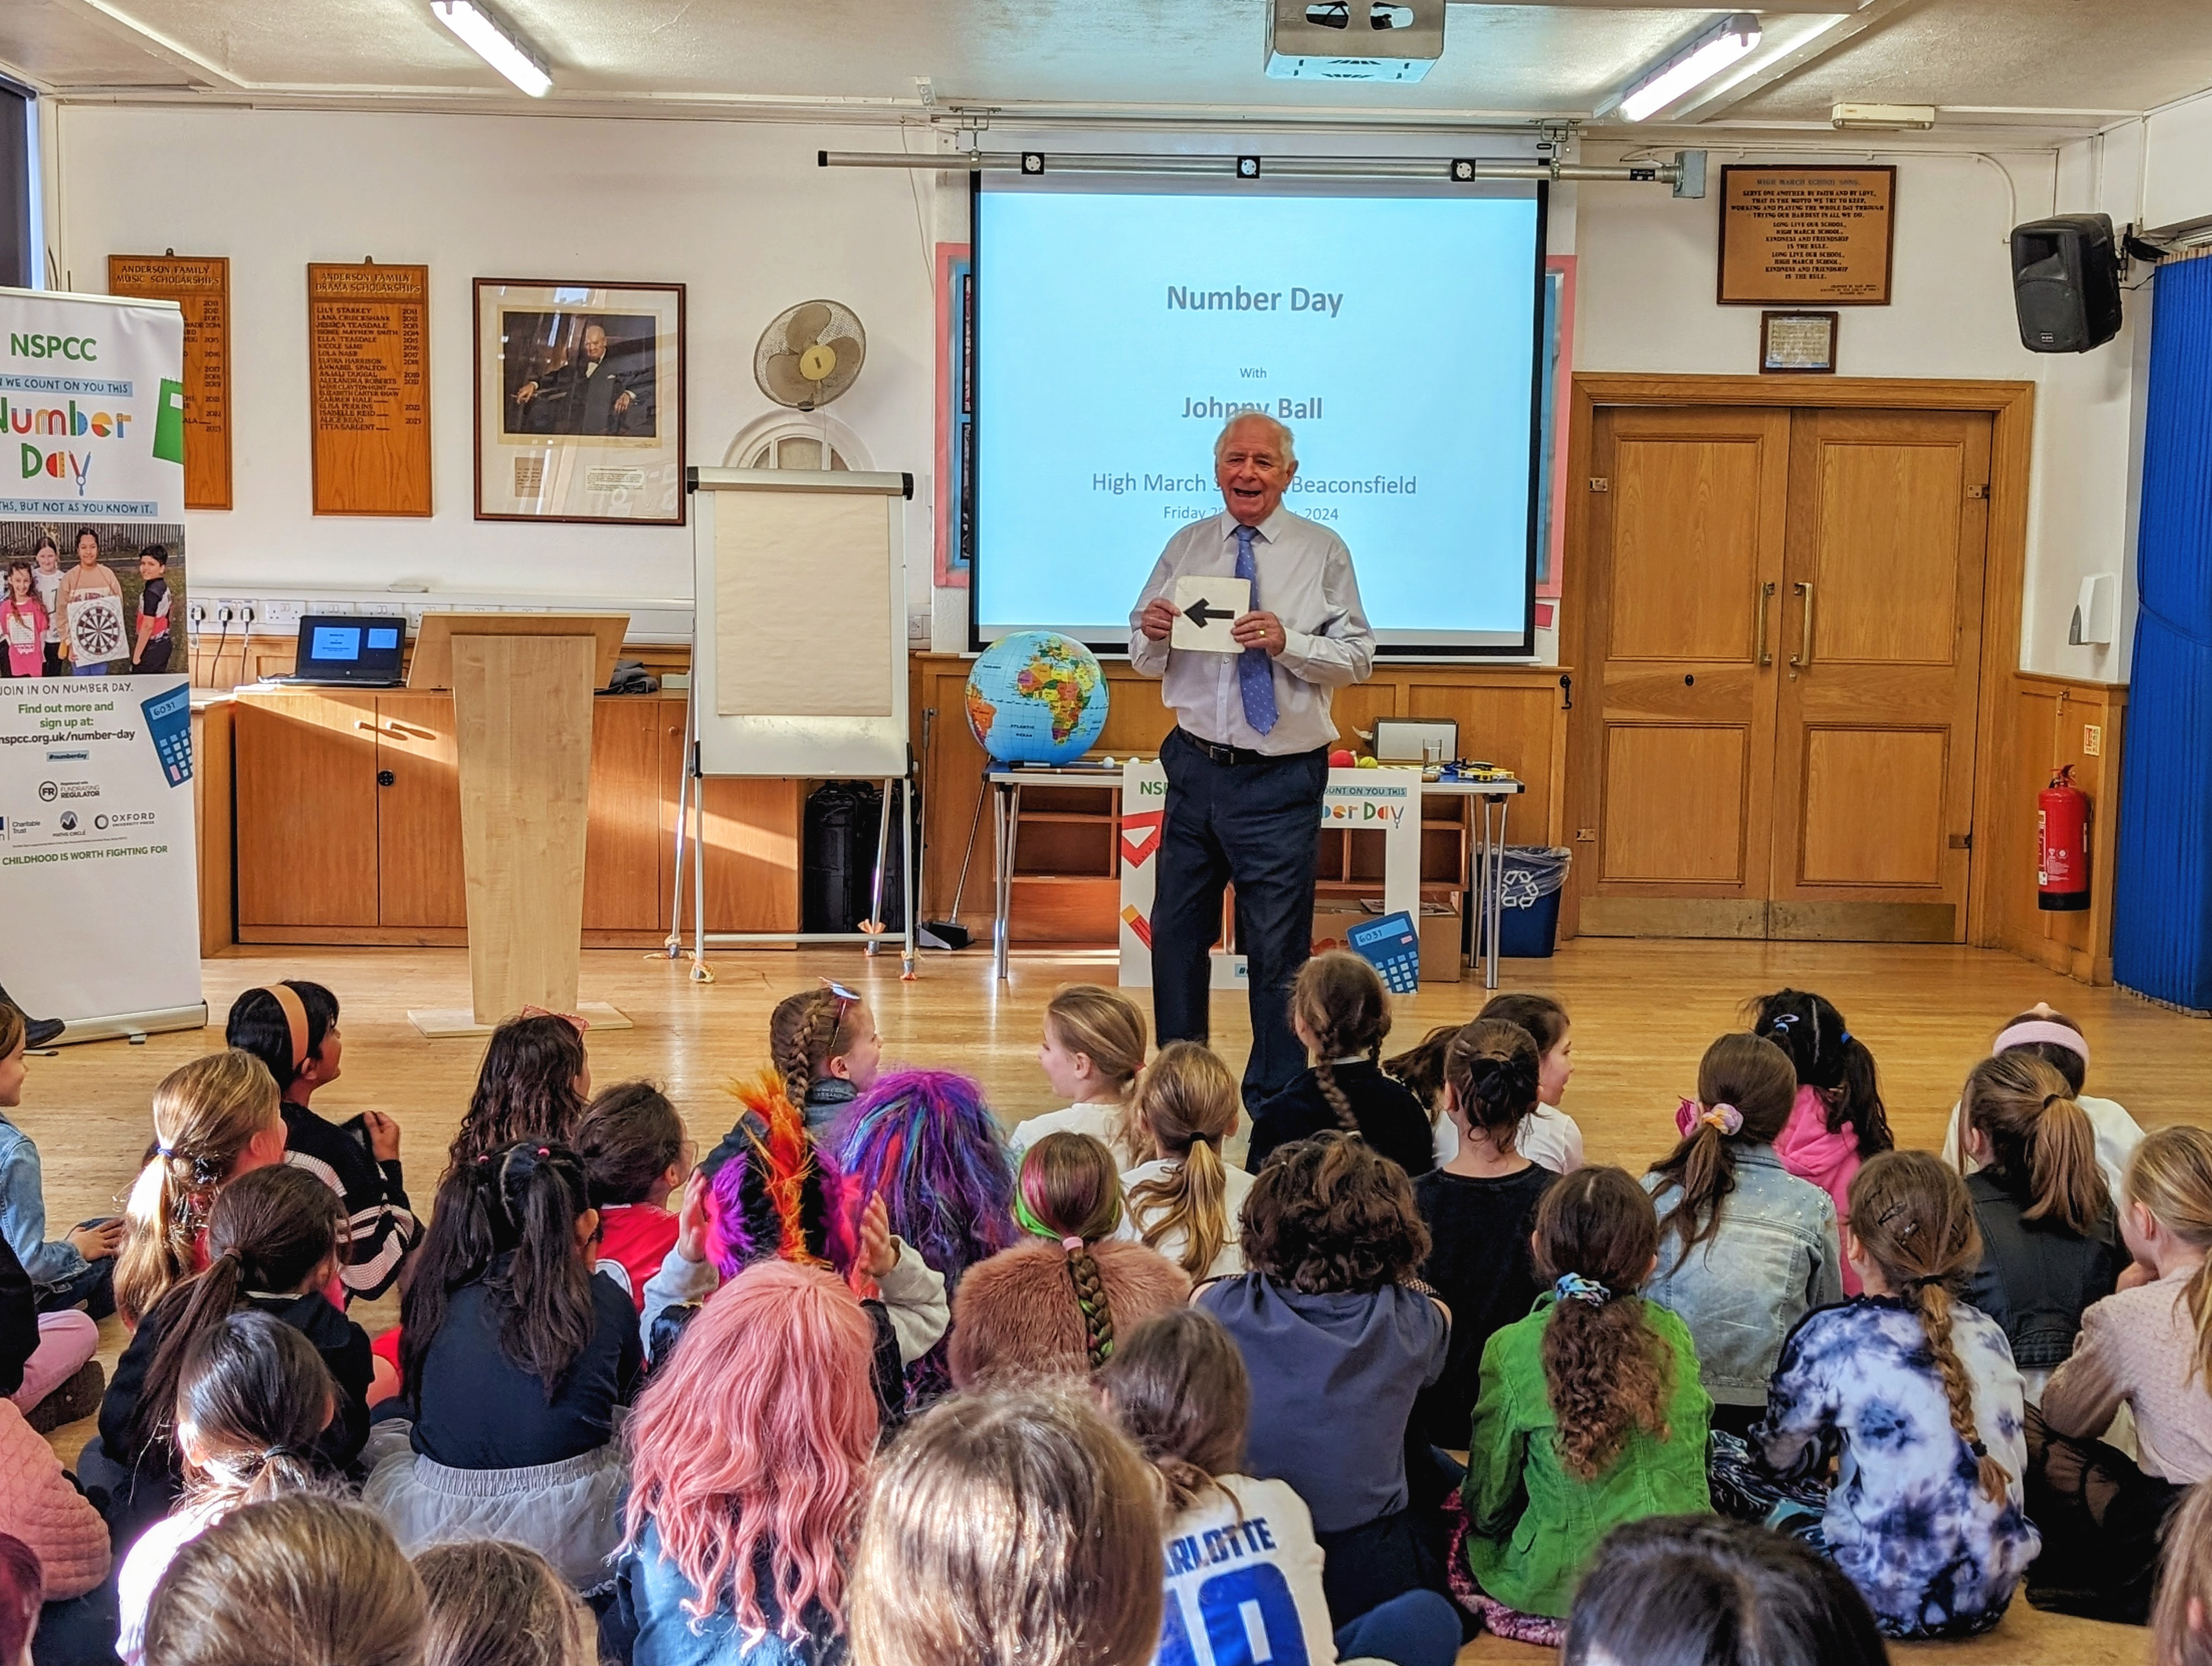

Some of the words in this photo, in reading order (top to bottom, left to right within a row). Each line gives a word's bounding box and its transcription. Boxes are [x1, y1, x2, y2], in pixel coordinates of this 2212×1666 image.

[151, 276, 219, 285] SCHOLARSHIPS
[351, 284, 420, 292] SCHOLARSHIPS
[1167, 286, 1282, 311] Number
[1291, 287, 1343, 318] Day
[11, 333, 97, 361] NSPCC
[1239, 367, 1267, 379] With
[6, 377, 20, 387] WE
[24, 379, 60, 389] COUNT
[64, 381, 79, 390] ON
[83, 382, 104, 392] YOU
[108, 383, 127, 393] THIS
[1278, 398, 1322, 419] Ball
[21, 443, 91, 496] Day
[1092, 473, 1136, 495] High
[1144, 473, 1206, 492] March
[1293, 475, 1417, 495] Beaconsfield
[0, 502, 17, 512] THS,
[21, 502, 39, 511] BUT
[43, 503, 64, 511] NOT
[82, 504, 103, 512] YOU
[107, 504, 138, 513] KNOW
[141, 505, 152, 514] IT.
[1305, 508, 1339, 521] 2024
[28, 685, 39, 695] IN
[43, 685, 59, 694] ON
[62, 683, 108, 693] NUMBER
[112, 682, 133, 692] DAY.
[18, 704, 41, 713] Find
[44, 704, 62, 713] out
[94, 701, 113, 711] and
[153, 702, 176, 716] 6031
[40, 717, 62, 729] sign
[65, 718, 78, 728] up
[80, 717, 94, 726] at:
[112, 812, 155, 822] OXFORD
[1320, 805, 1358, 819] ber
[1364, 802, 1404, 829] Day
[2, 854, 59, 866] CHILDHOOD
[61, 853, 68, 861] IS
[70, 850, 104, 860] WORTH
[106, 847, 148, 857] FIGHTING
[151, 845, 168, 854] FOR
[1359, 930, 1382, 943] 6031
[1164, 1517, 1277, 1577] RLOTTE
